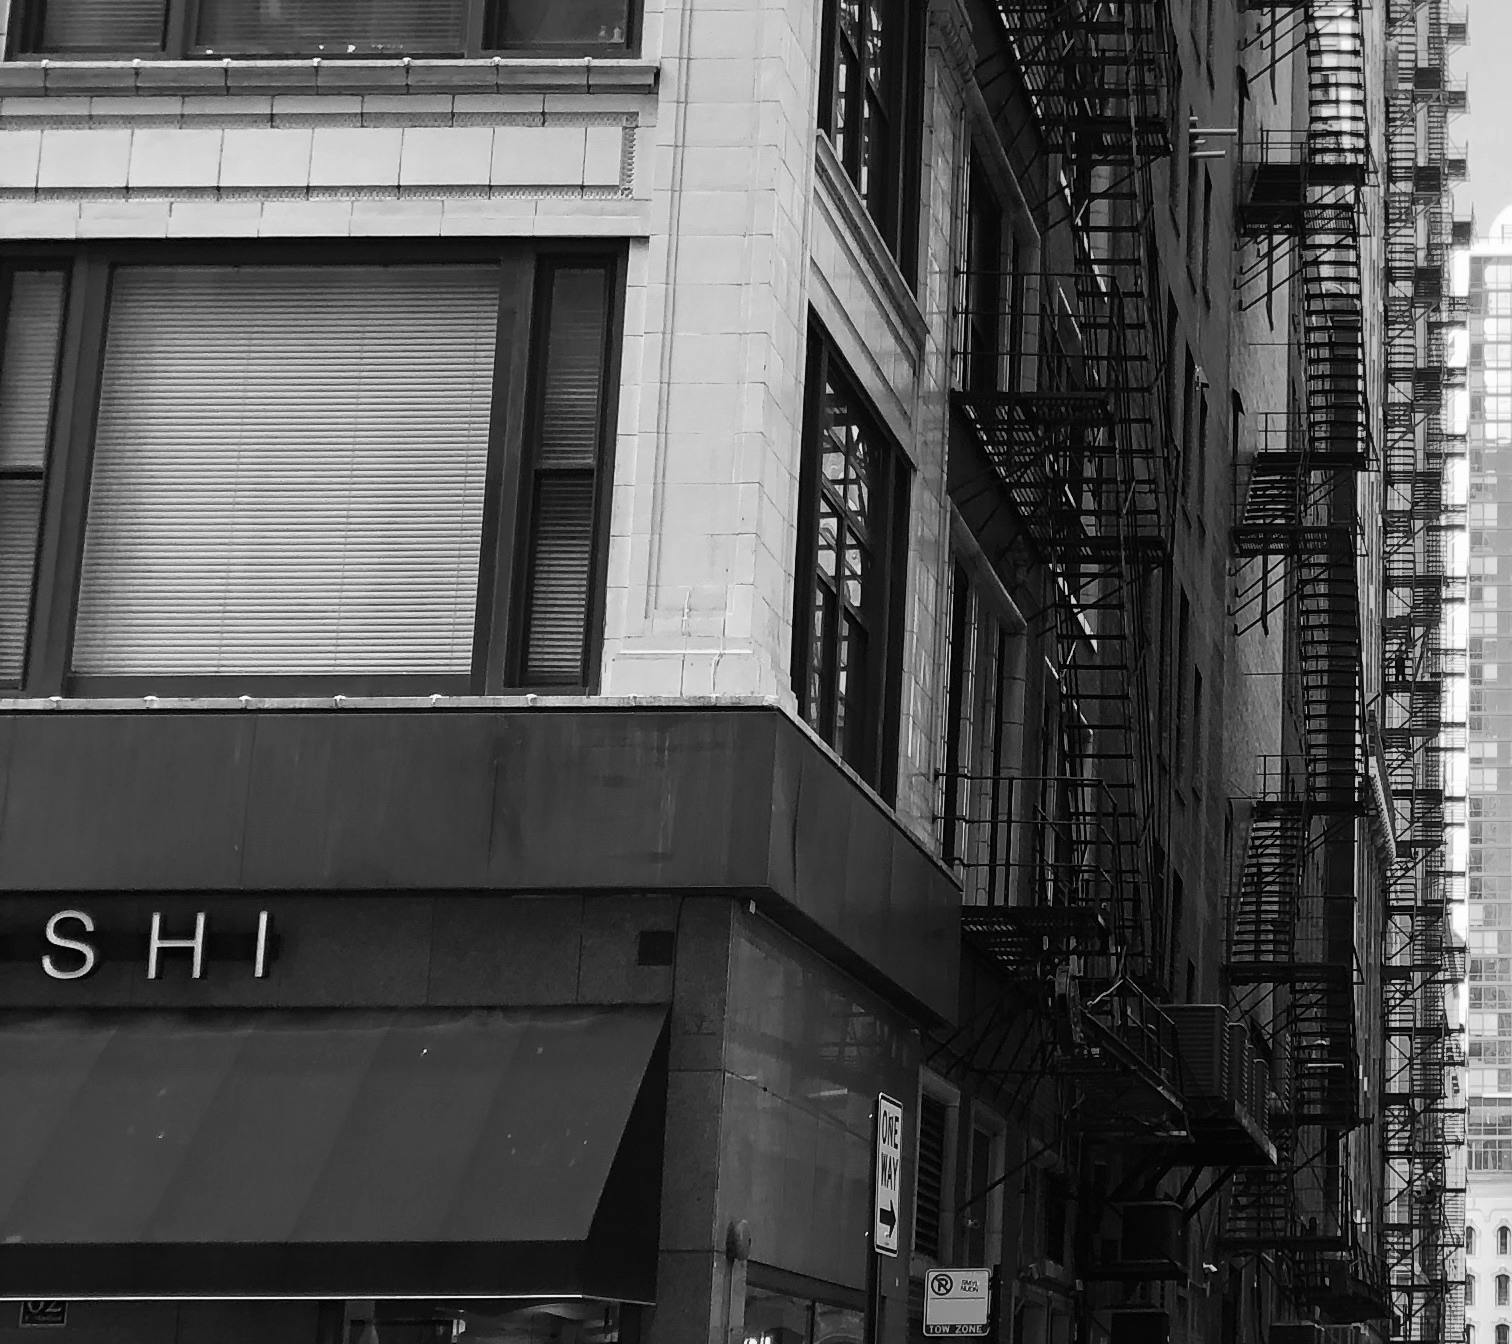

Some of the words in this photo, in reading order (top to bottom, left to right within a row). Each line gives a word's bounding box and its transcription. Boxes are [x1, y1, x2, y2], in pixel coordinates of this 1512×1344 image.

[41, 909, 268, 979] SHI
[882, 1109, 899, 1150] ONE
[881, 1151, 899, 1191] WAY
[930, 1325, 950, 1334] TOW
[955, 1325, 983, 1334] ZONE
